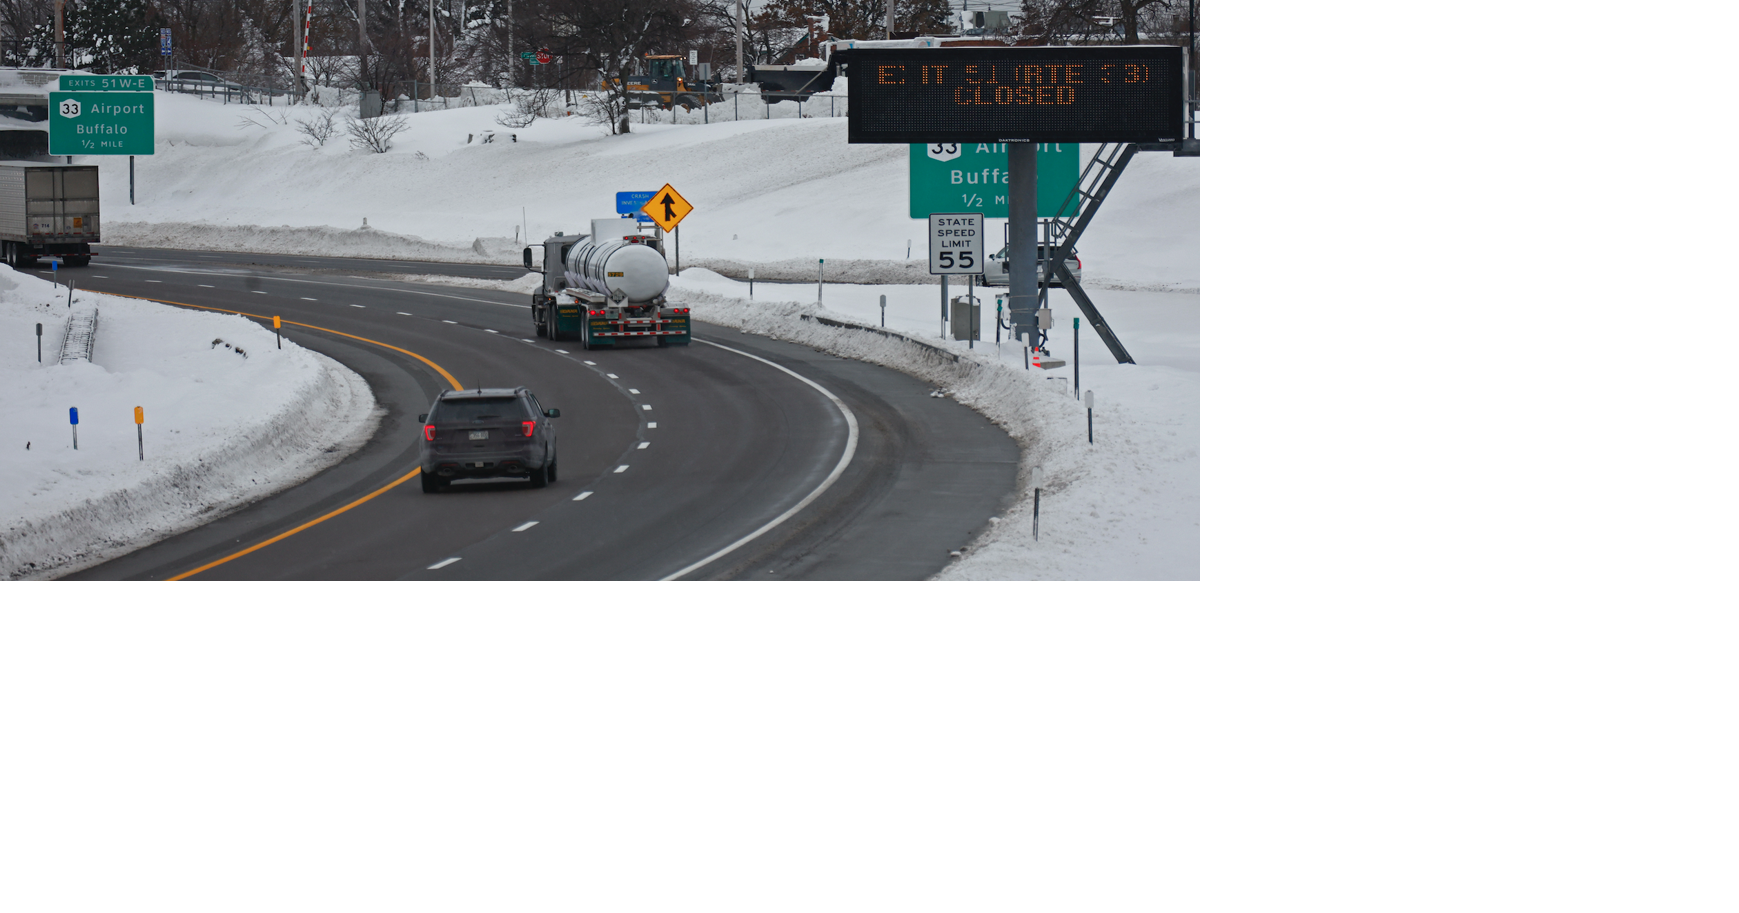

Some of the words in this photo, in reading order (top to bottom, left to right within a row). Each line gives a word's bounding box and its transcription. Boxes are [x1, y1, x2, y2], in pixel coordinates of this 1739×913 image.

[68, 79, 96, 87] EXITS
[955, 86, 1075, 104] CLOSED
[62, 103, 79, 115] 33
[91, 103, 145, 116] Airport
[77, 123, 128, 134] Buffalo
[975, 143, 1062, 154] Airrt
[938, 218, 975, 226] STATE
[937, 229, 976, 237] SPEED
[941, 240, 972, 248] LIMIT
[939, 251, 975, 269] 55
